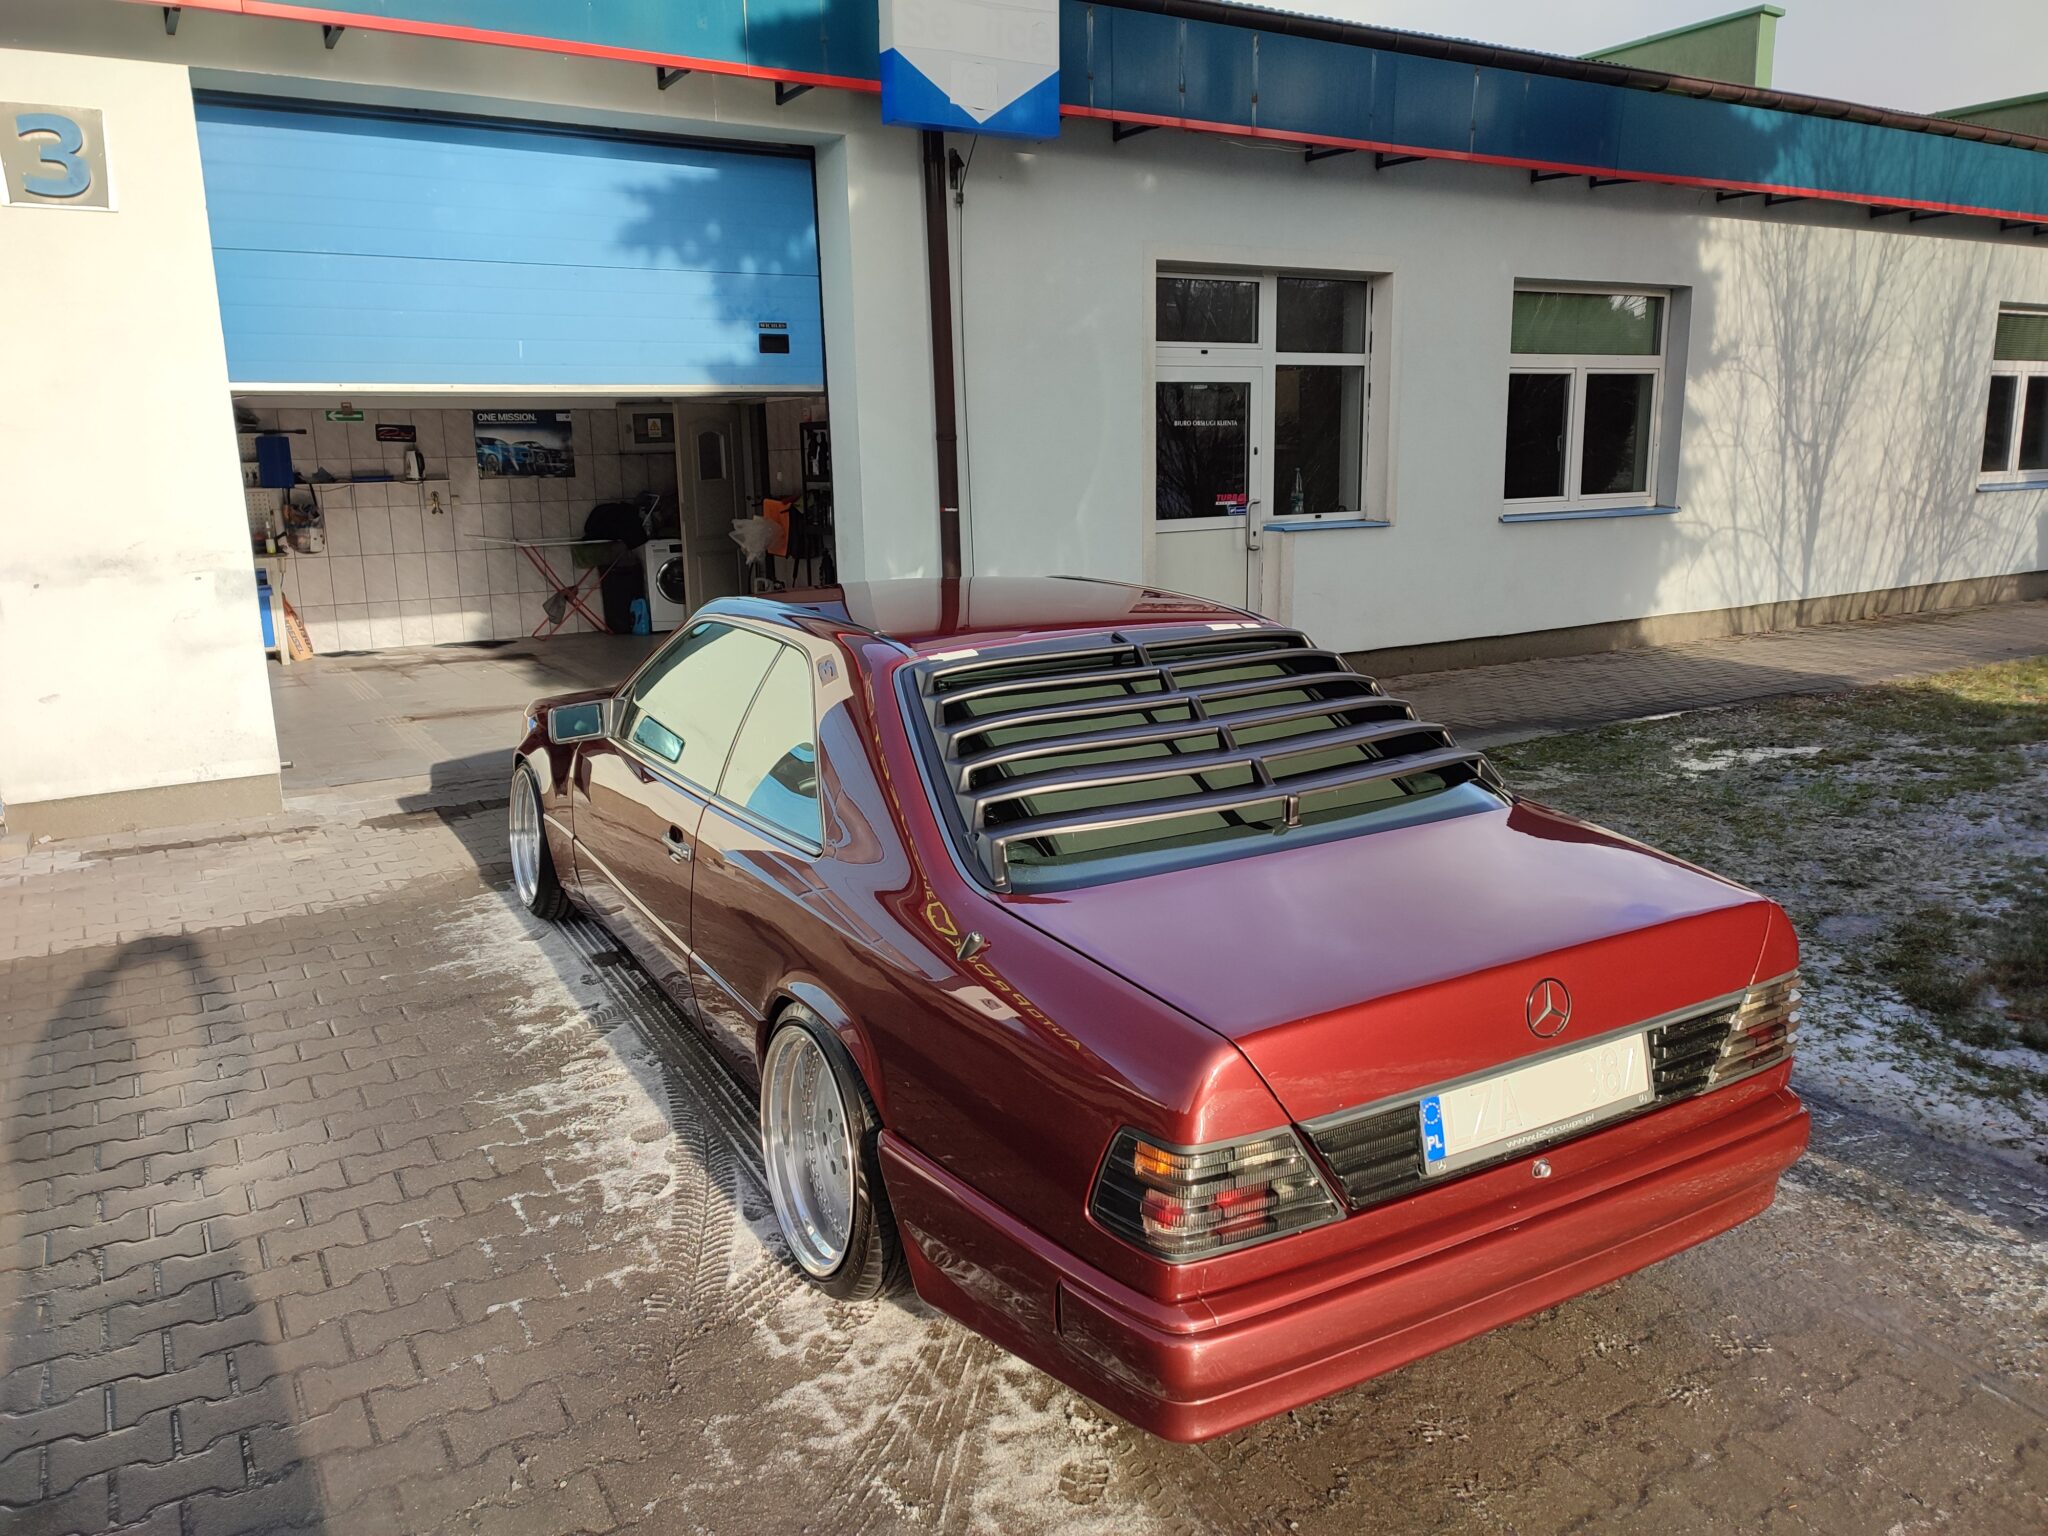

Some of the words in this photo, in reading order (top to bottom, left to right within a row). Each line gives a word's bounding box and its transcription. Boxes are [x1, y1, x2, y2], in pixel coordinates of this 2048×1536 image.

[14, 112, 92, 199] 3
[477, 412, 497, 421] ONE
[497, 412, 537, 421] MISSION.
[1427, 1136, 1443, 1151] PL
